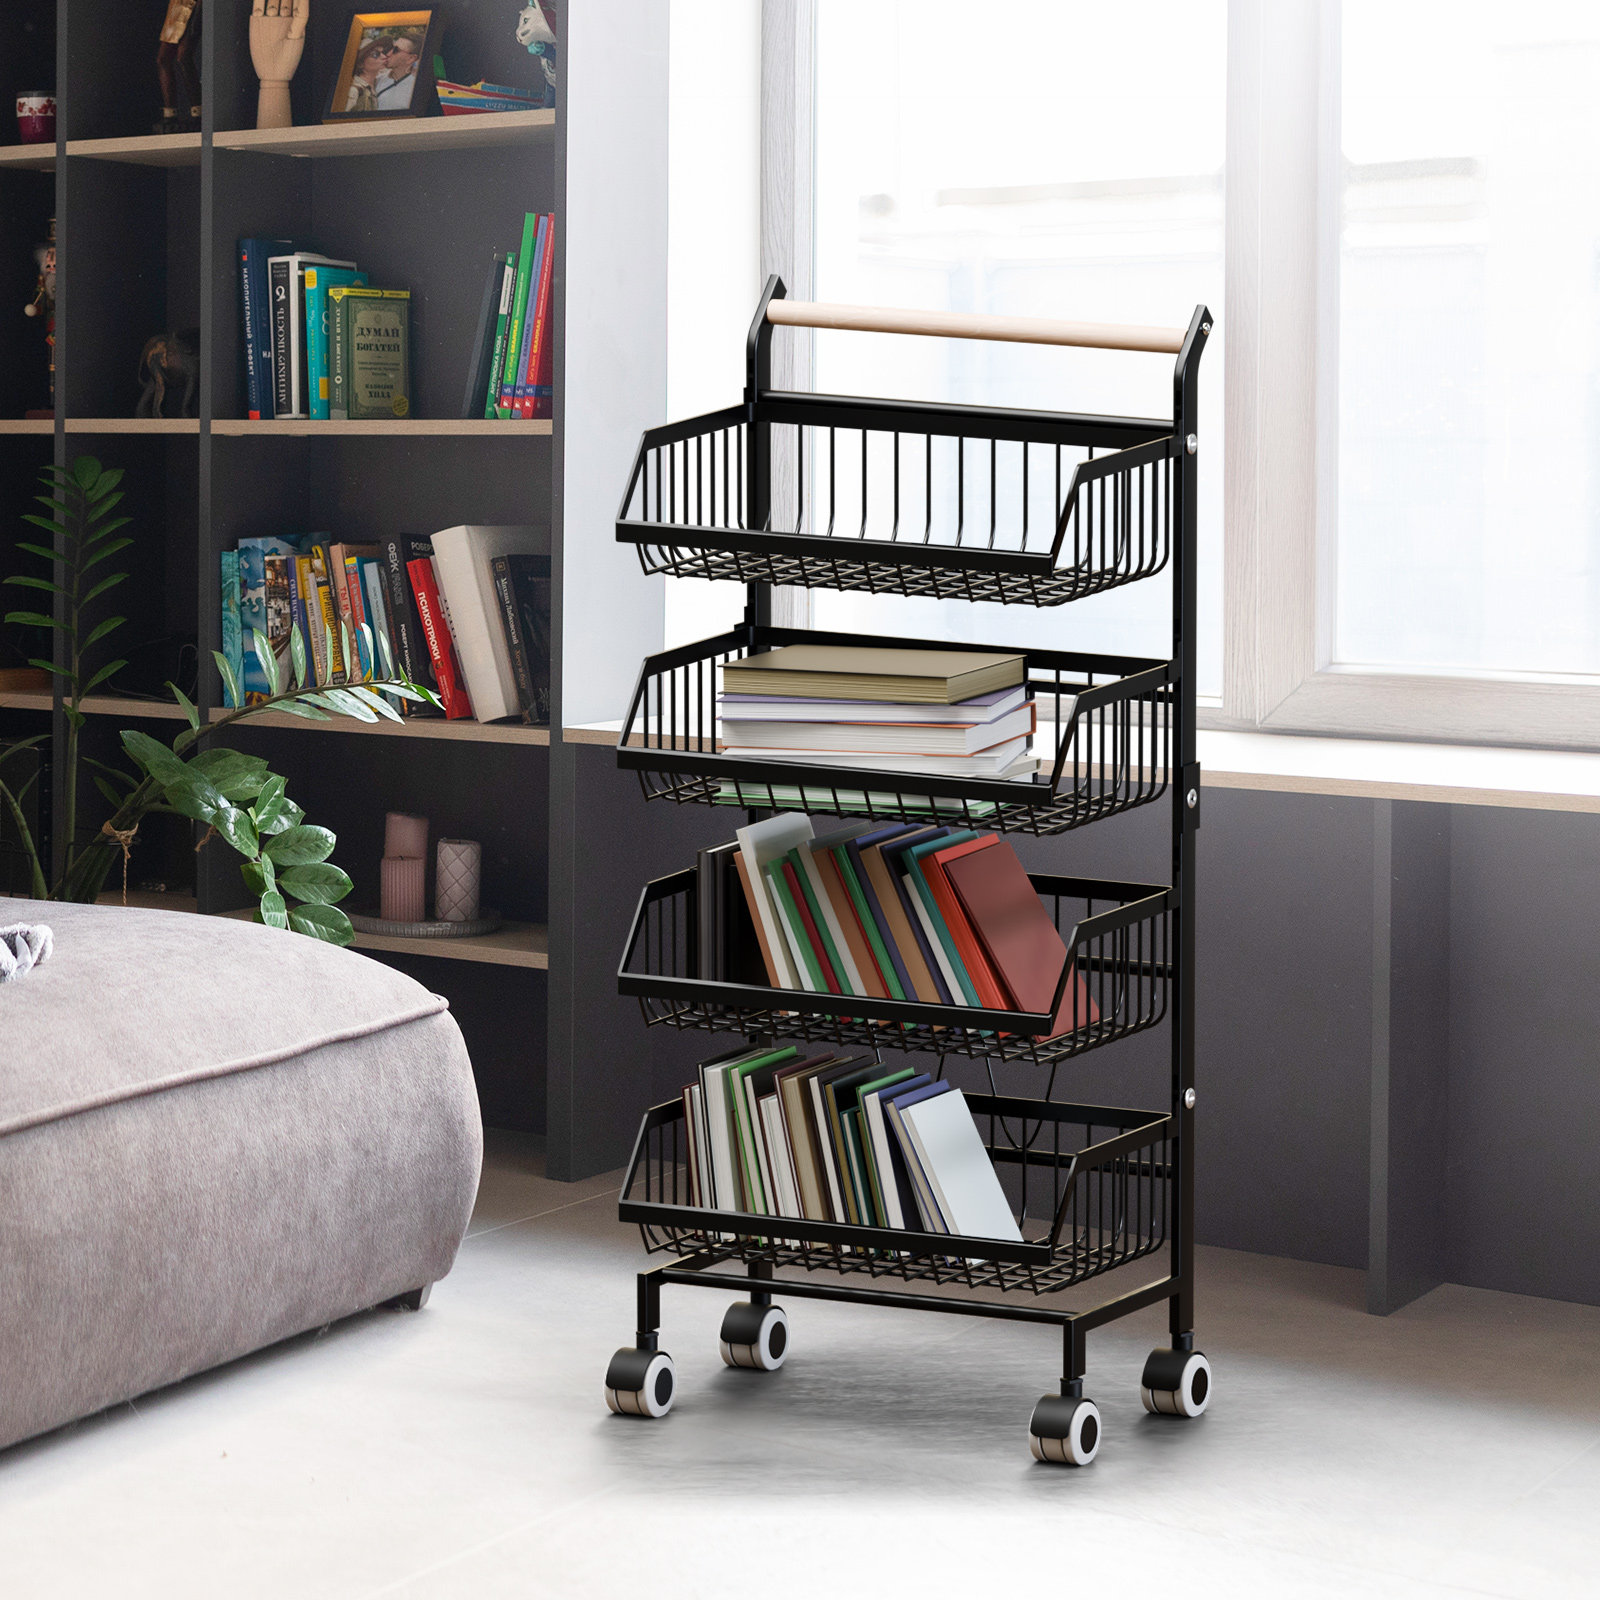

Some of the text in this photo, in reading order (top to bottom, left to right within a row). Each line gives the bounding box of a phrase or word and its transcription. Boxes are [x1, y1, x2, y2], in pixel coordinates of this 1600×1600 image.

[242, 267, 253, 339] НАКОПИТЕЛЬНЫЙ
[356, 326, 400, 338] ДУМАЙ
[356, 342, 401, 353] БОГАТЕЙ
[511, 320, 519, 353] GRAMMAR
[533, 320, 541, 353] GRAMMAR
[276, 307, 287, 405] АНТИХРУПКОСТЬ
[388, 542, 399, 573] ФЕЙК
[411, 542, 433, 551] РОБЕР
[340, 586, 348, 600] ТЫ
[417, 592, 441, 660] ПСИХОТРЮКИ
[501, 577, 510, 604] Михаил
[506, 604, 519, 645] Лабковский
